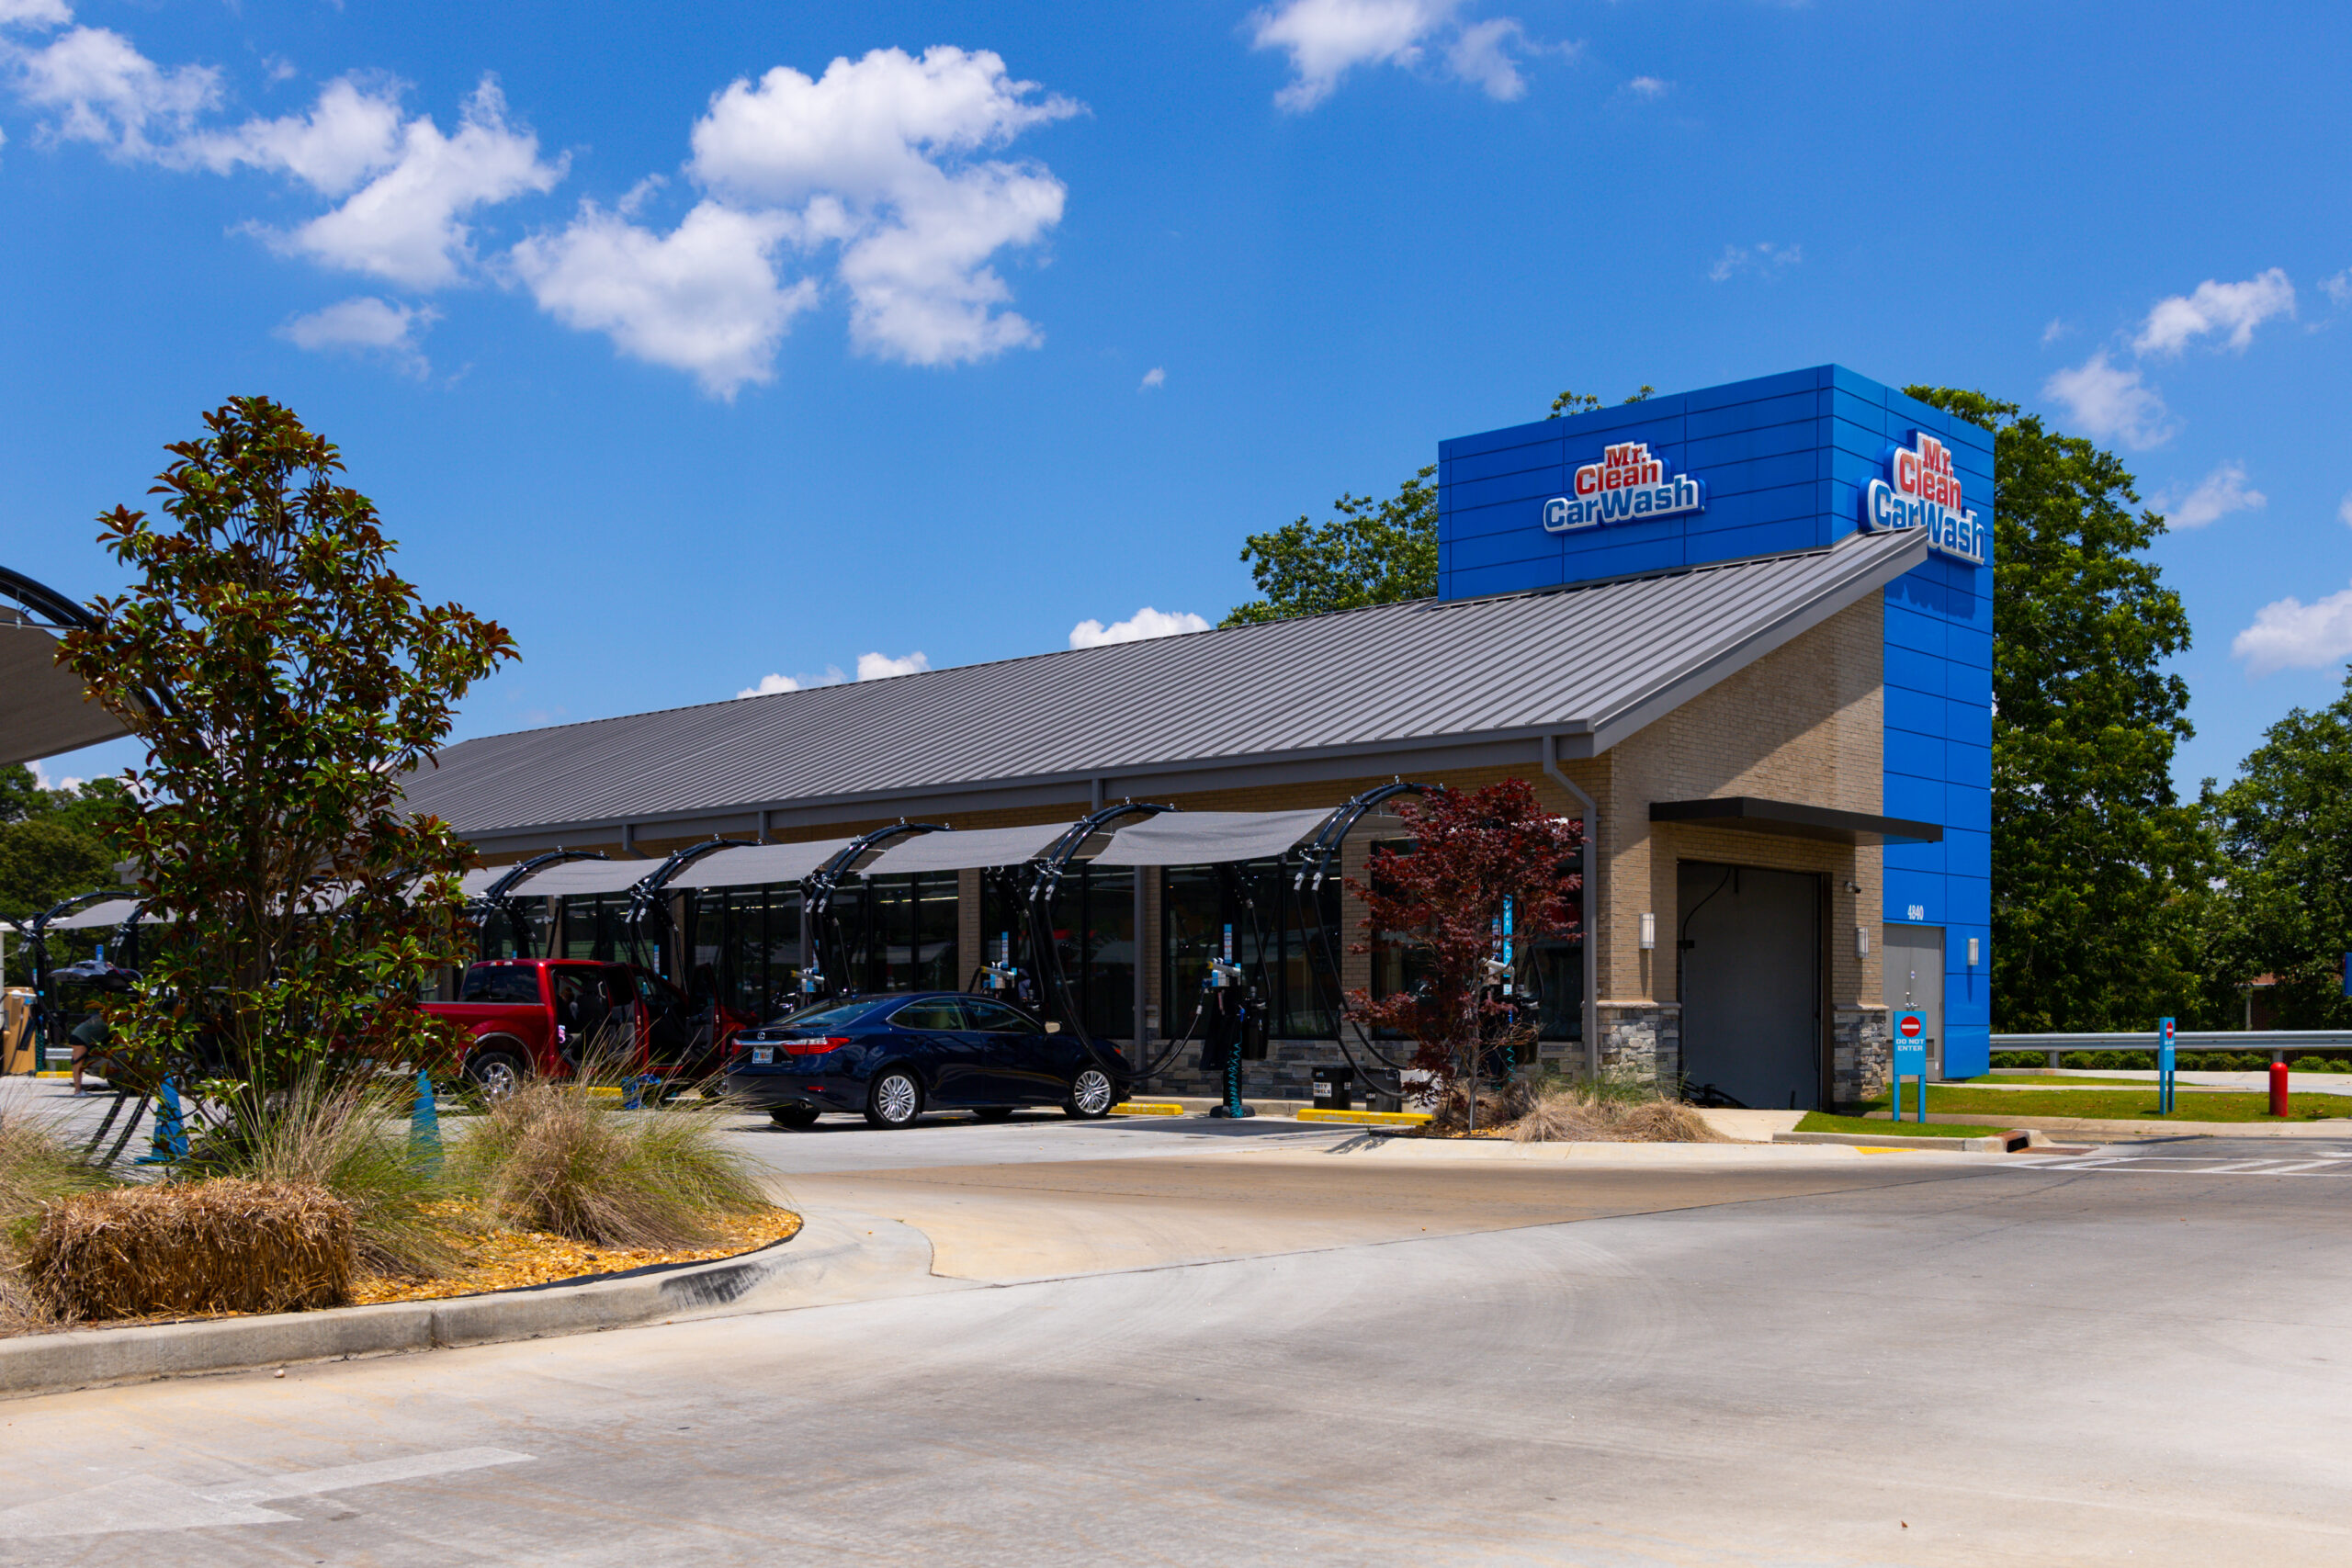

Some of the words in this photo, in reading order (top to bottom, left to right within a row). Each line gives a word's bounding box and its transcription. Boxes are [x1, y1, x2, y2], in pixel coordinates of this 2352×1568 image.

[1605, 446, 1647, 468] Mr.
[1922, 438, 1954, 478] Mr.
[1576, 462, 1658, 495] Clean
[1899, 452, 1962, 511] Clean
[1907, 904, 1924, 920] 4840
